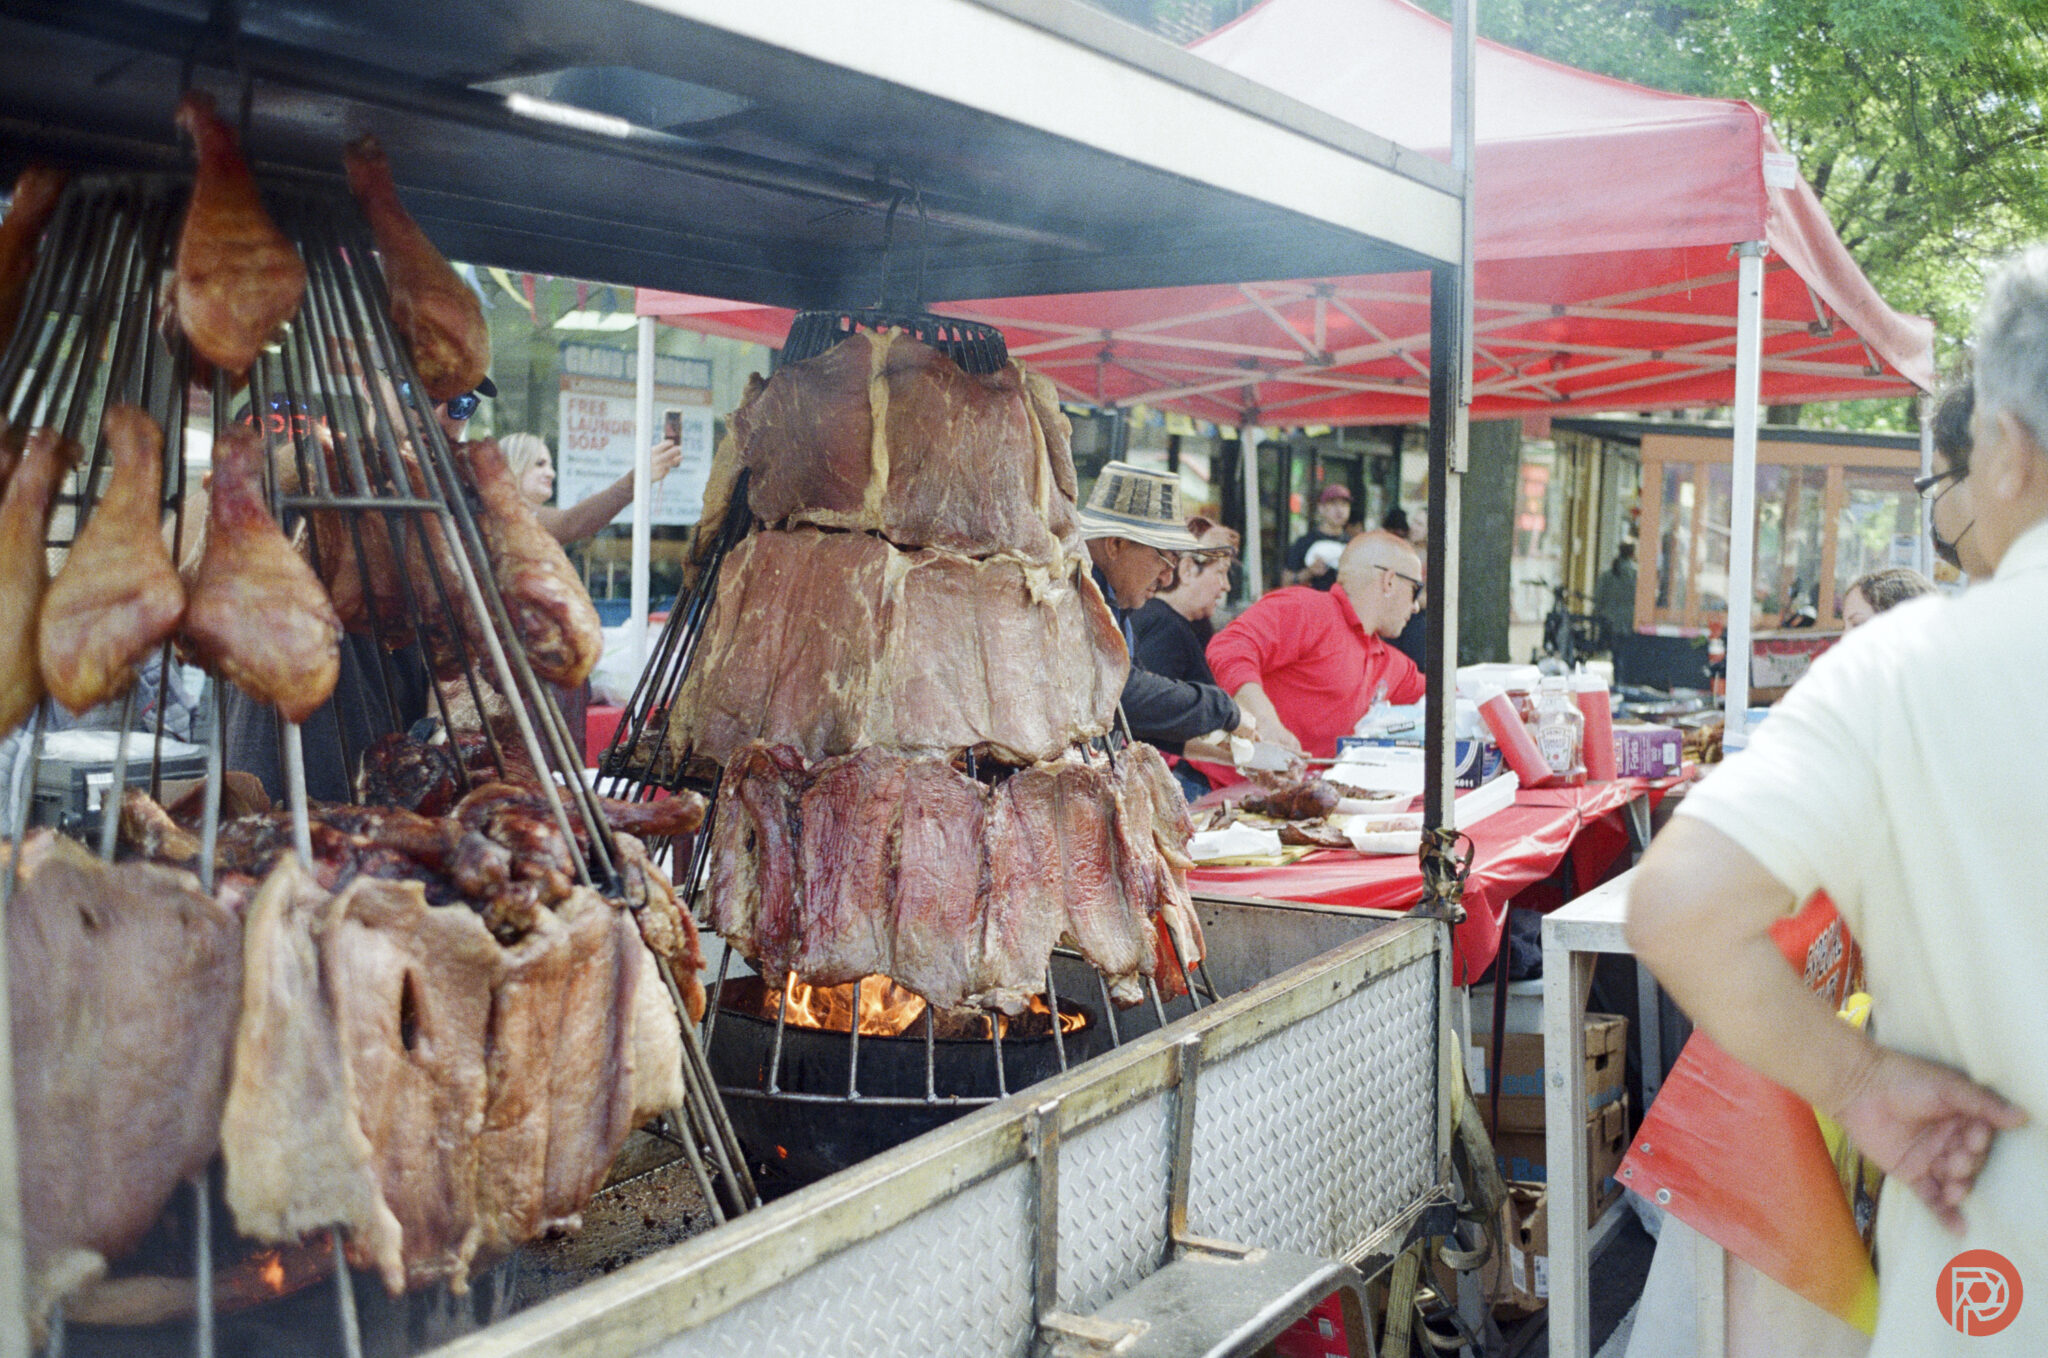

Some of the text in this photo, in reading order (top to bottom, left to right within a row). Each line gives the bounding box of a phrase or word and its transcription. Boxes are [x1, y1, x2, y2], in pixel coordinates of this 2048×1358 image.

[568, 398, 606, 415] FREE
[567, 416, 636, 436] LAUNDR
[568, 434, 609, 451] SOAP
[1630, 741, 1640, 770] Forks
